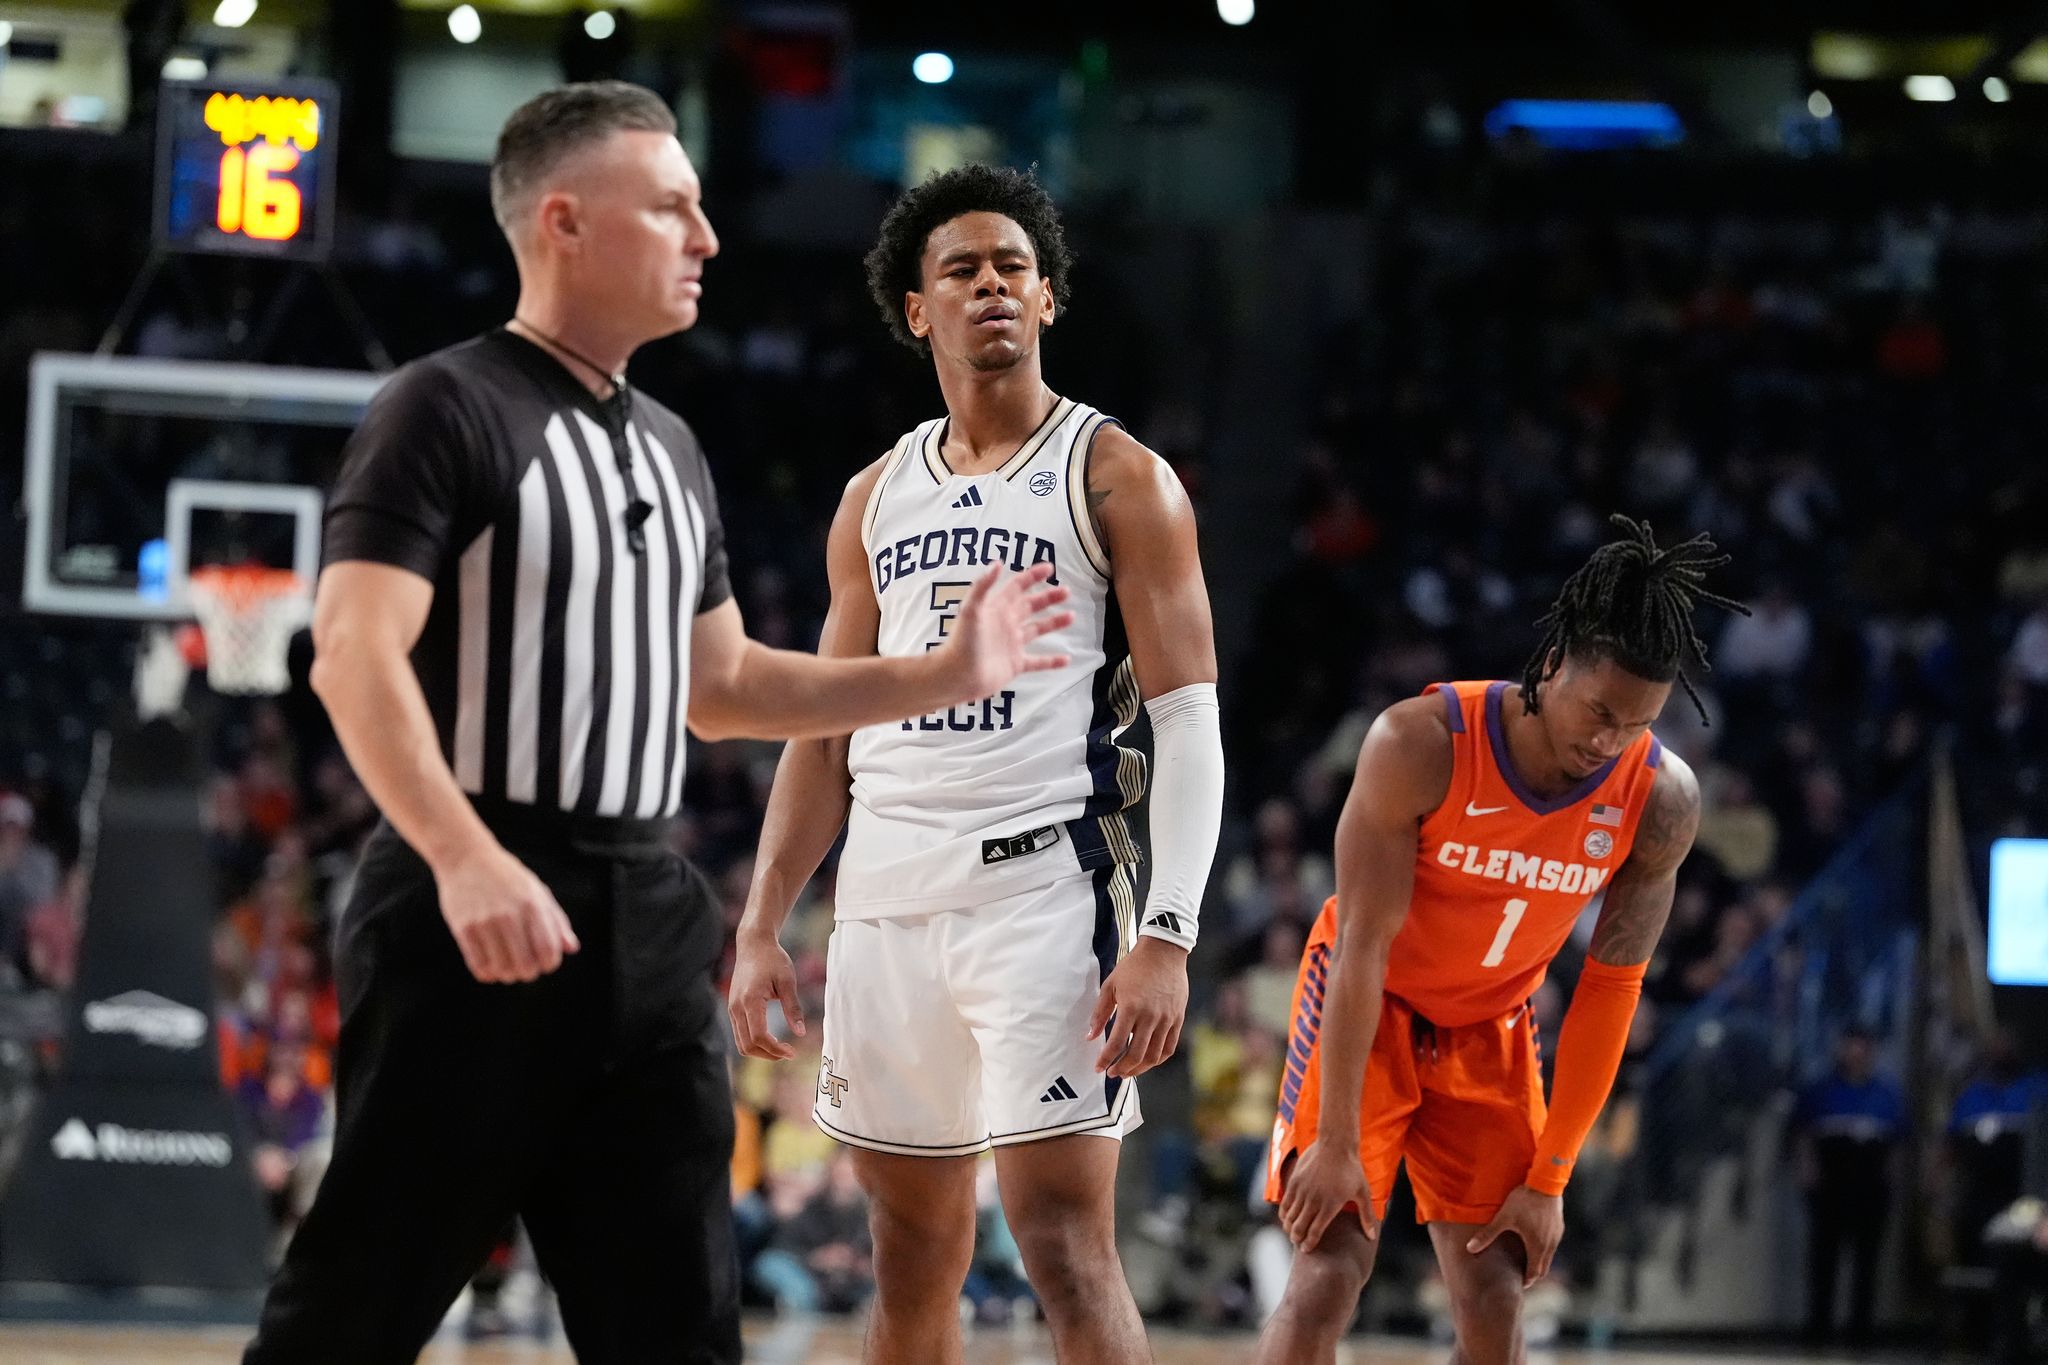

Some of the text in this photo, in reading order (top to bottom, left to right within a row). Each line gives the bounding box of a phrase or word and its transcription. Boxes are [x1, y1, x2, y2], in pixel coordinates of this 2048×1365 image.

[217, 141, 302, 240] 16
[1033, 477, 1056, 486] ACC
[876, 527, 1060, 595] GEORGIA
[1020, 843, 1027, 852] S
[1437, 841, 1609, 895] CLEMSON
[1480, 898, 1528, 968] 1
